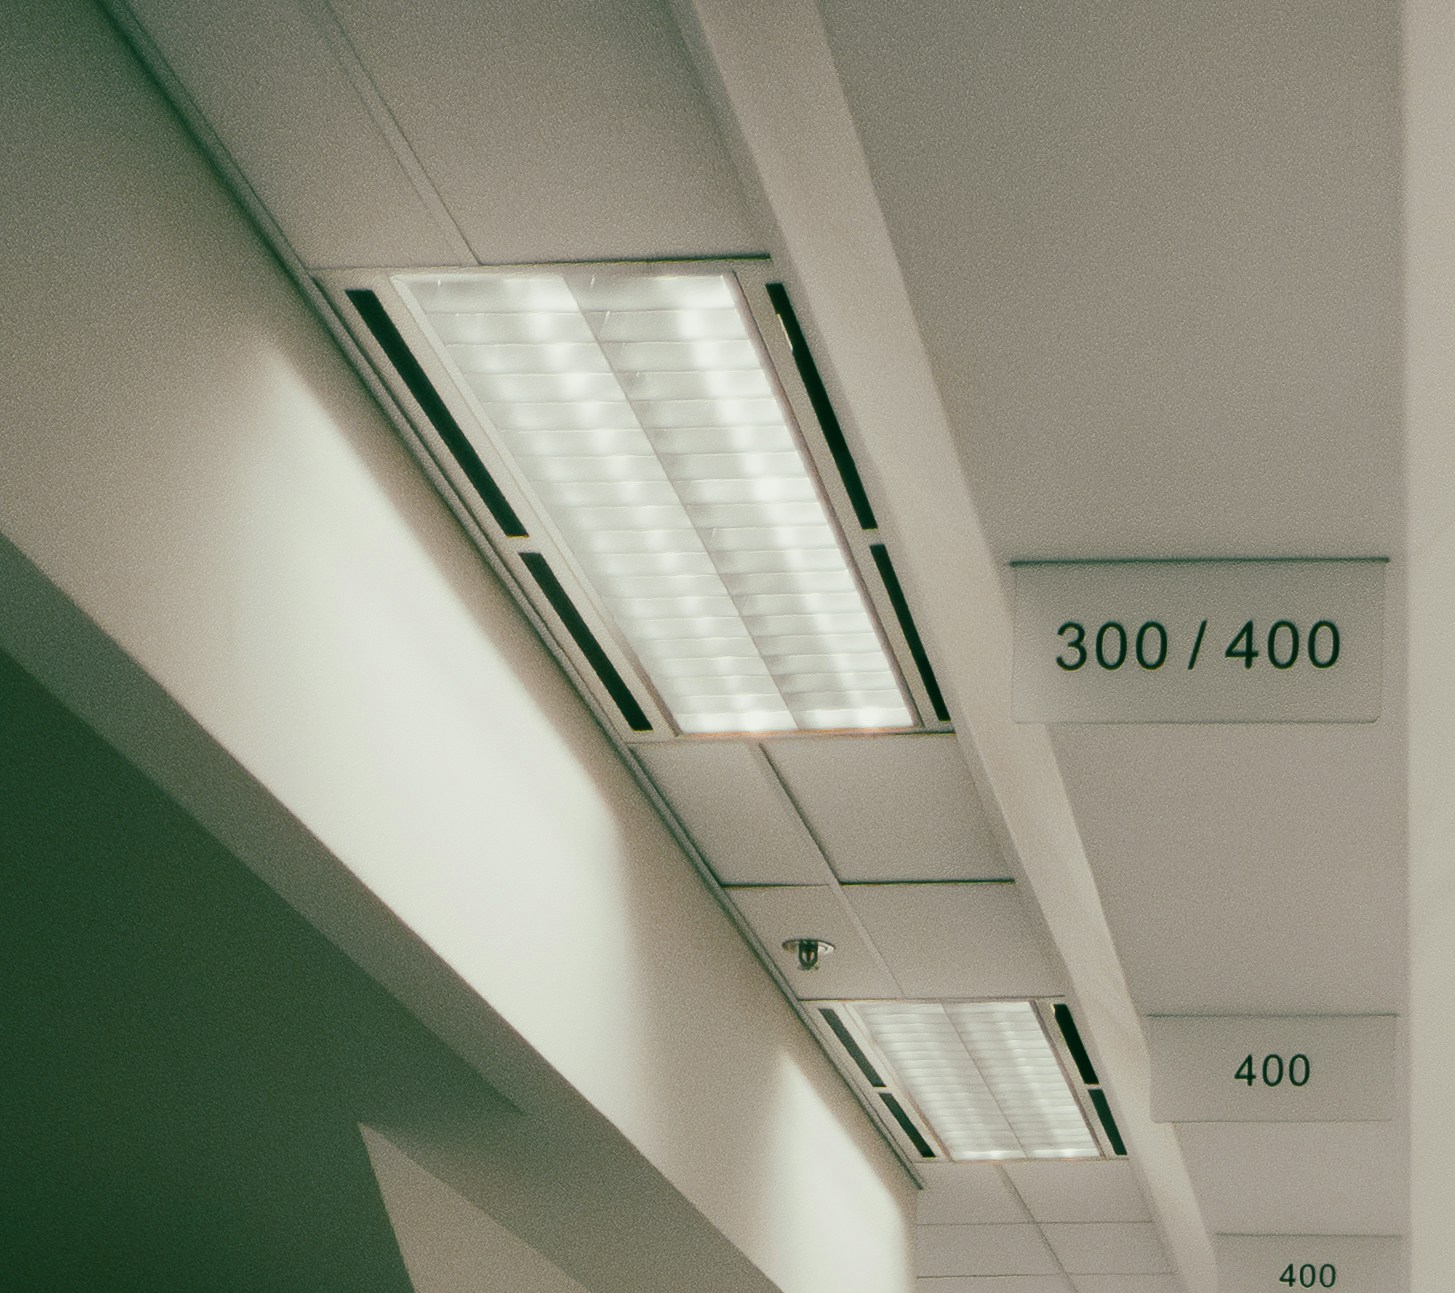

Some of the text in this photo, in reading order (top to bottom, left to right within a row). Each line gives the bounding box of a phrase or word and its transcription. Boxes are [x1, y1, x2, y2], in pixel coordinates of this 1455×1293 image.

[1057, 621, 1339, 670] 300 / 400
[1235, 1054, 1309, 1086] 400
[1280, 1264, 1336, 1288] 400
